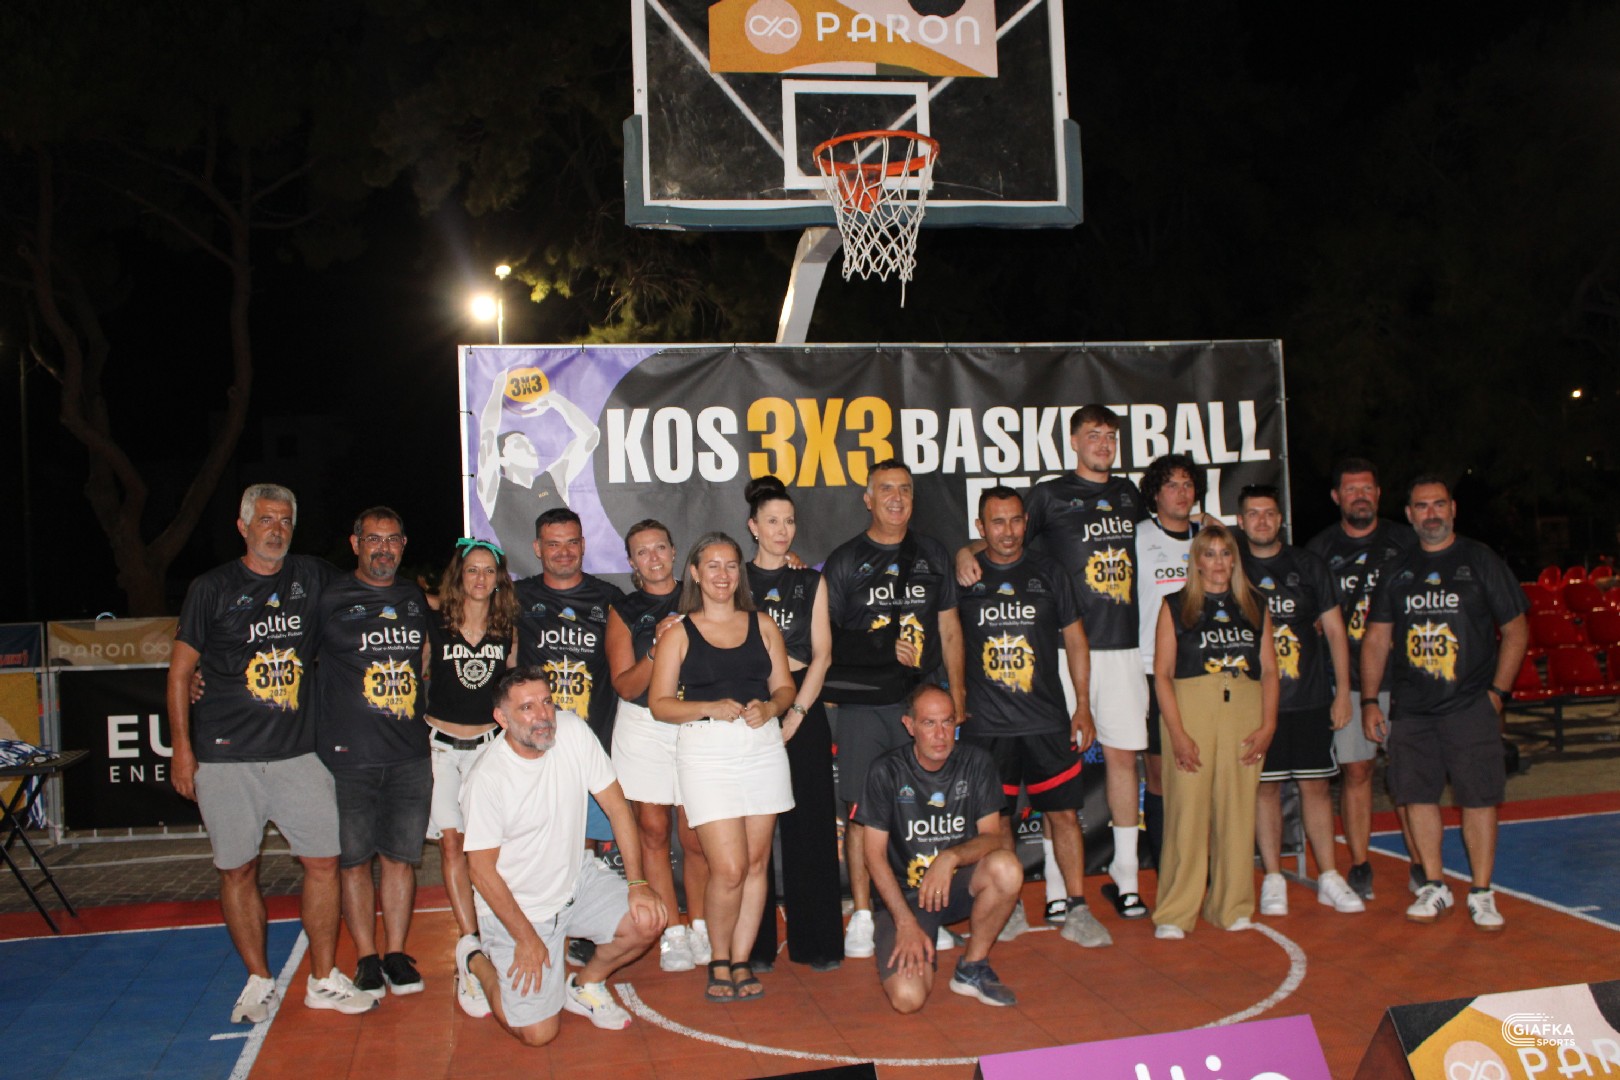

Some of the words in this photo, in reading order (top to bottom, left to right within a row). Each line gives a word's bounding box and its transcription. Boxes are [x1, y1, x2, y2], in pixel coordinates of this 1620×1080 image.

[816, 11, 981, 45] PARON
[606, 406, 738, 483] KOS
[746, 396, 894, 487] 3X3
[1155, 566, 1188, 579] COS
[866, 582, 926, 605] jolie
[58, 643, 135, 658] PARON
